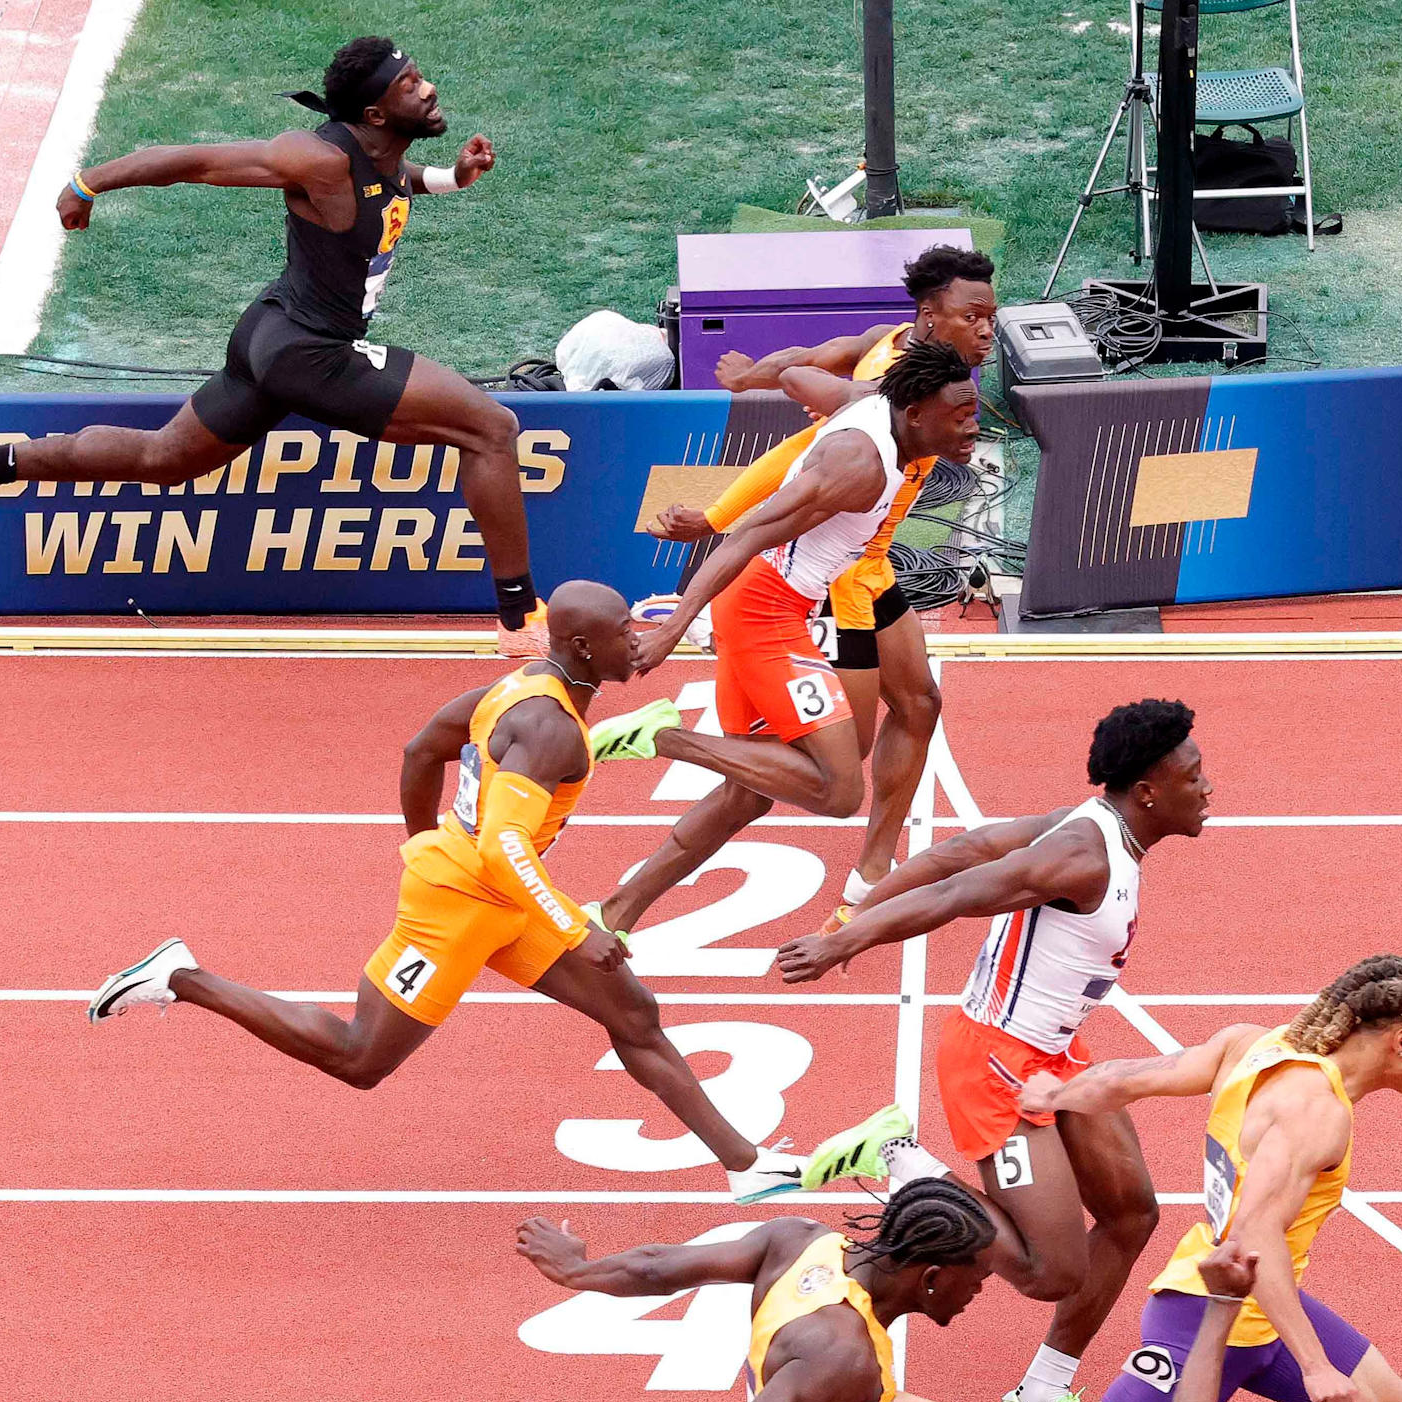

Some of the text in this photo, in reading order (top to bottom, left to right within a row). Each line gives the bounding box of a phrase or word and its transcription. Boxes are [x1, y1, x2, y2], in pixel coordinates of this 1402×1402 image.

[24, 507, 486, 575] WIN HERE
[797, 680, 825, 717] 3
[498, 830, 574, 931] VOLUNTEERS
[617, 840, 827, 977] 2
[395, 959, 427, 995] 4
[554, 1021, 813, 1172] 3
[1002, 1140, 1022, 1185] 5
[518, 1221, 780, 1391] 4
